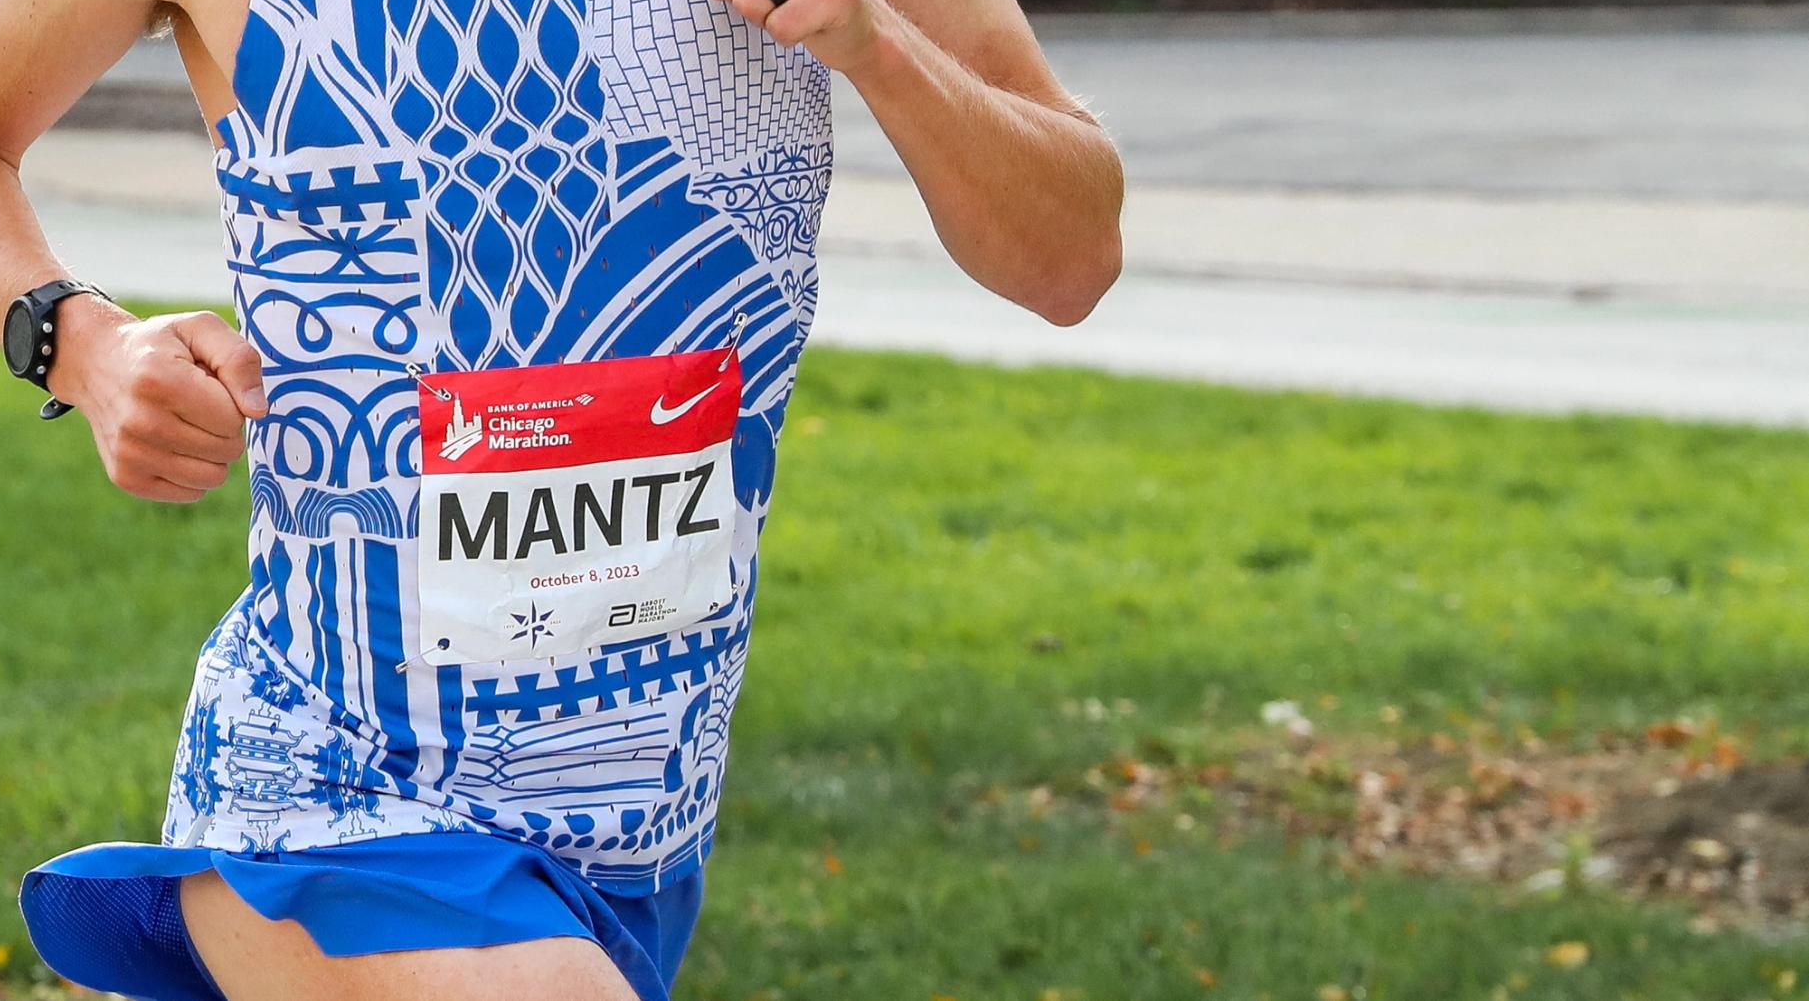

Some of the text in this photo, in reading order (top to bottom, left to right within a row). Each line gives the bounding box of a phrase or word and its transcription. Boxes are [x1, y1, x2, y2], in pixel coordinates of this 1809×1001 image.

[487, 399, 574, 413] BANK OF AMERICA
[488, 417, 555, 433] Chicago
[438, 461, 720, 560] MANTZ
[530, 565, 640, 589] October 8, 2023
[640, 604, 663, 612] WORLD
[641, 598, 666, 607] ABBOTT
[639, 608, 677, 618] MARATHON
[638, 616, 665, 624] MAJORS
